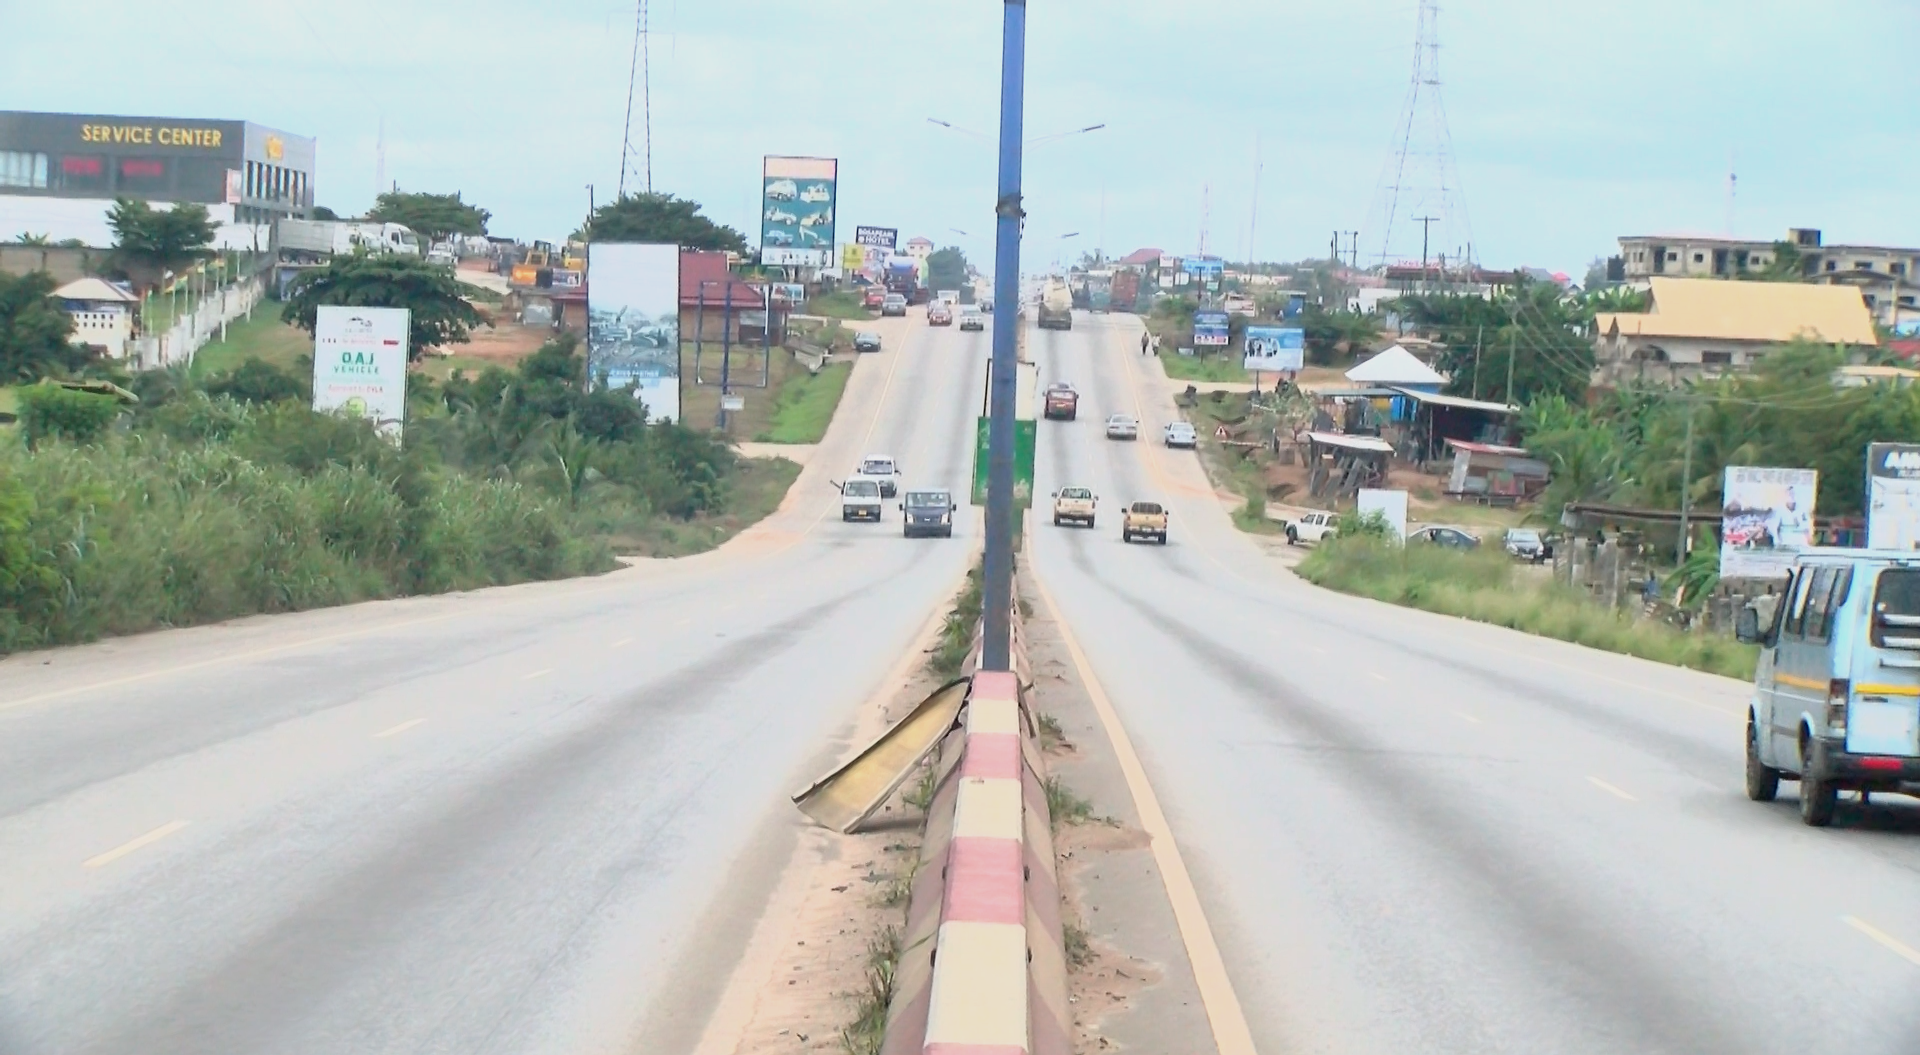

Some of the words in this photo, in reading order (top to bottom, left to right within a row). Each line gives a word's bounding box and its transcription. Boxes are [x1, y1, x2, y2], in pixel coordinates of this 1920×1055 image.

[81, 123, 153, 144] SERVICE
[157, 126, 223, 147] CENTER
[865, 235, 891, 246] HOTEL
[333, 365, 380, 375] VEHICLE
